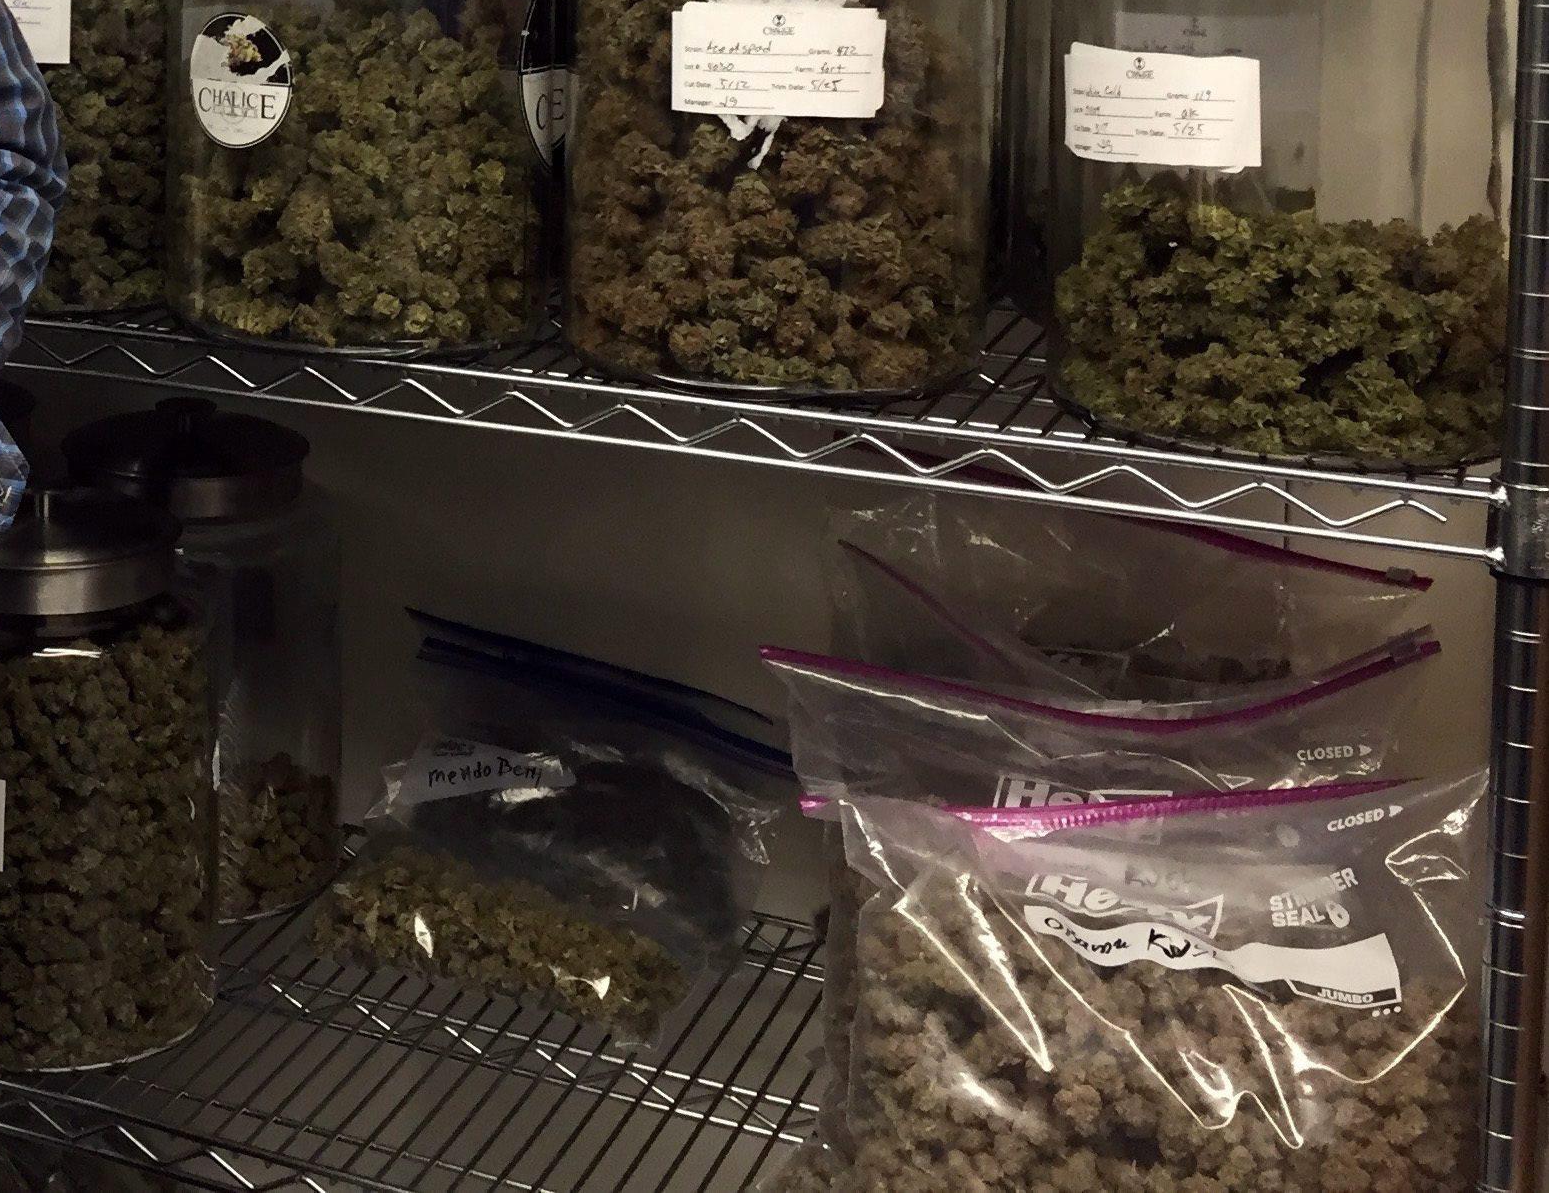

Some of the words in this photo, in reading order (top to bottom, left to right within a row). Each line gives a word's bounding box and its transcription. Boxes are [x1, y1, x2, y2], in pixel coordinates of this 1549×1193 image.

[198, 87, 276, 120] CHALICE
[1296, 746, 1354, 762] CLOSED
[1327, 808, 1384, 832] CLOSED
[1272, 909, 1326, 929] SEAL
[1317, 988, 1375, 1005] JUMBO
